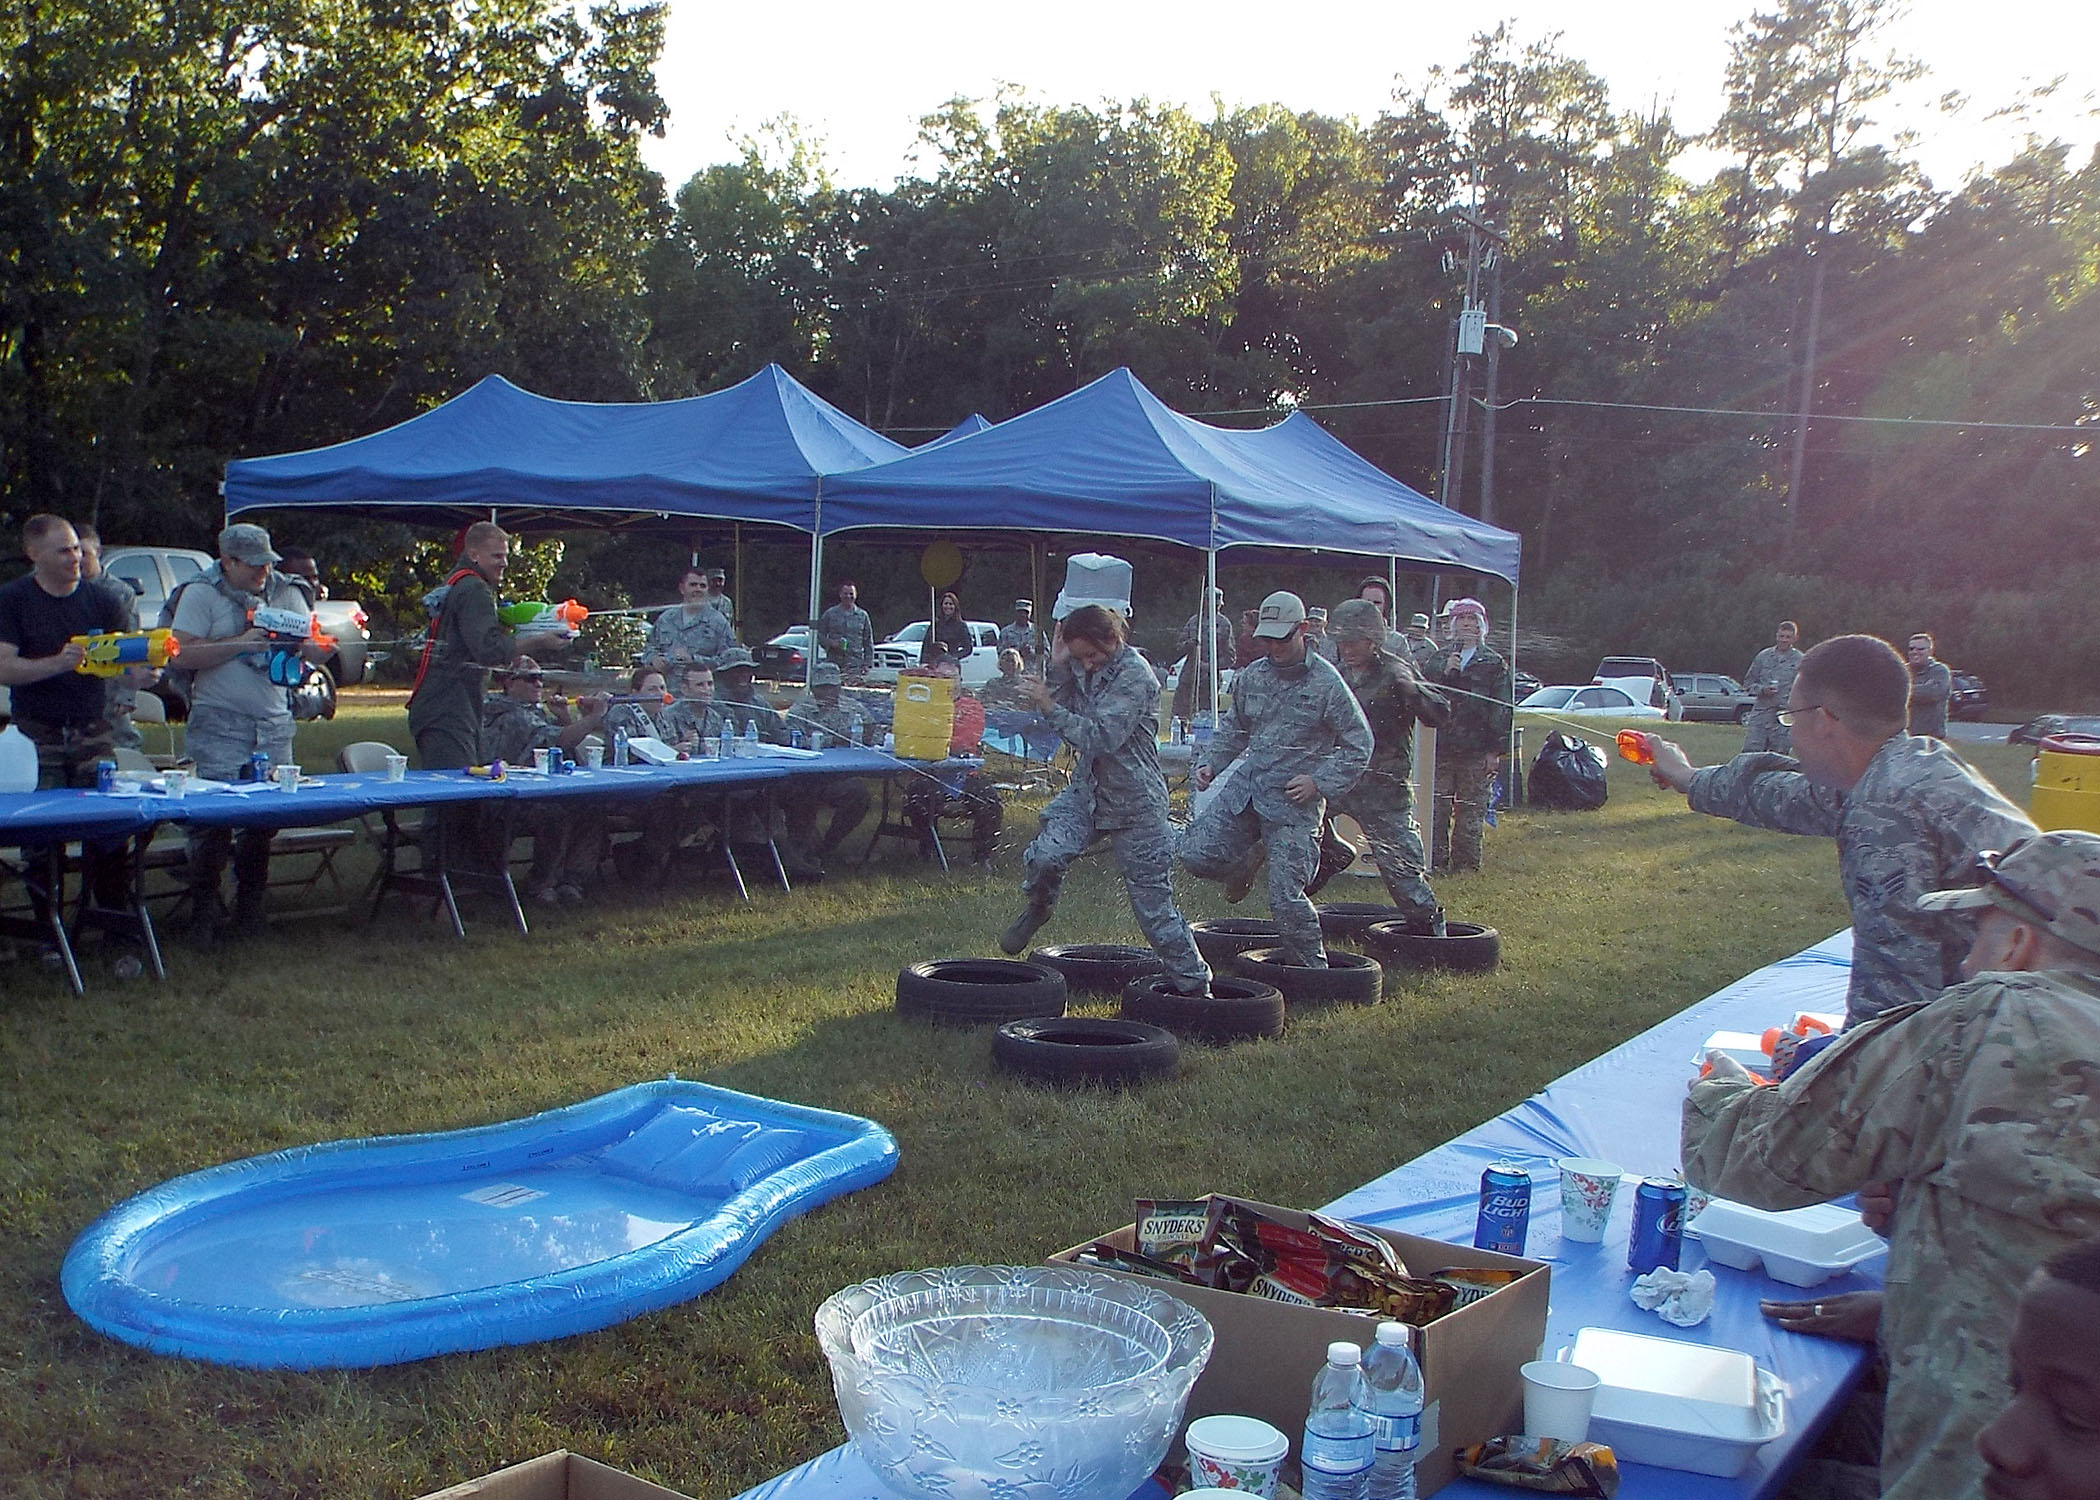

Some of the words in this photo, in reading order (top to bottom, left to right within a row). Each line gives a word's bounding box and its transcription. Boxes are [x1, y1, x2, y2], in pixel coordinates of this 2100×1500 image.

[1492, 1195, 1528, 1208] BUD
[1483, 1204, 1528, 1217] LIGHT
[1144, 1219, 1205, 1235] SNYDER'S
